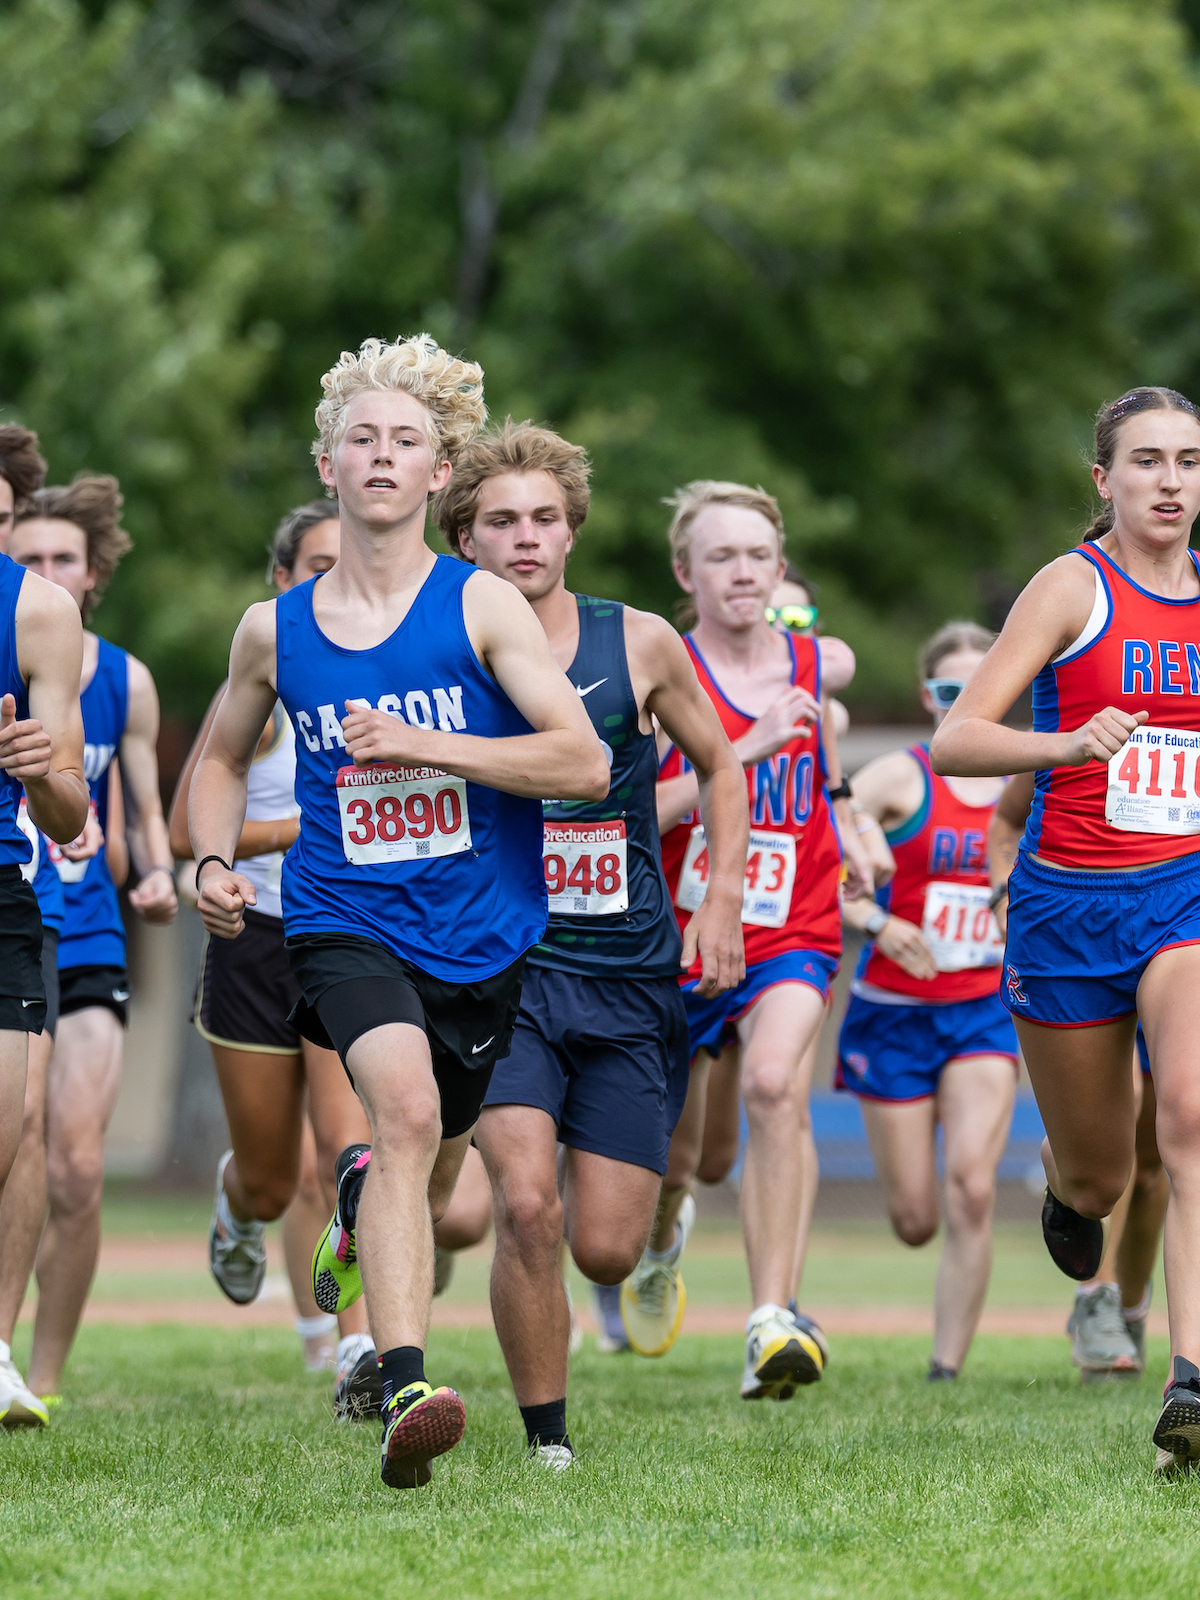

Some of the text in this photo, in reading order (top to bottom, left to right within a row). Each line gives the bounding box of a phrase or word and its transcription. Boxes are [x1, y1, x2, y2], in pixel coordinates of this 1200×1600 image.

[1128, 733, 1143, 743] un
[1146, 731, 1162, 745] for
[346, 788, 462, 845] 3890
[543, 827, 621, 843] oreducation
[542, 853, 621, 895] 948
[692, 846, 787, 893] 443
[932, 904, 1002, 946] 410
